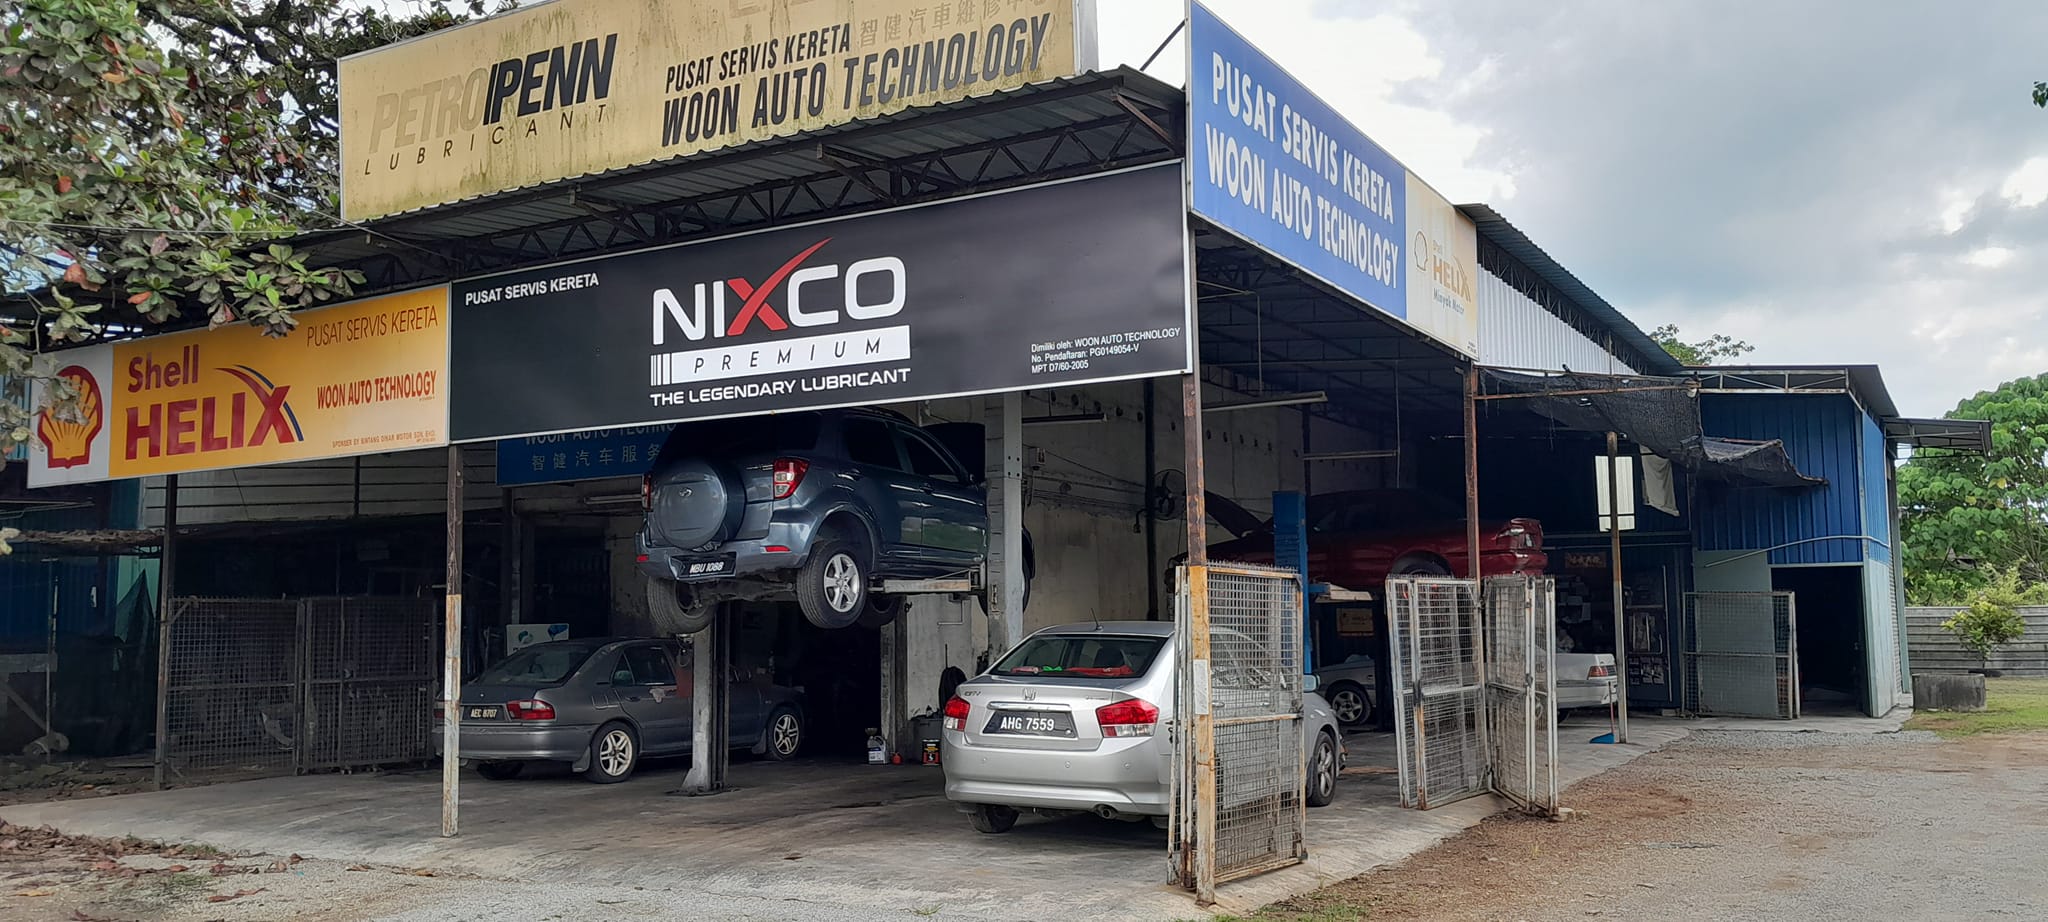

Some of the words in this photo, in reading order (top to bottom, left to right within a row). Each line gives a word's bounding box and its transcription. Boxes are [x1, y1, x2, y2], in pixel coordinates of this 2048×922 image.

[661, 83, 741, 147] WOON
[751, 62, 827, 128] AUTO
[843, 13, 1051, 110] TECHNOLOGY
[665, 55, 713, 93] PUSAT
[719, 39, 779, 81] SERVIS
[784, 23, 851, 64] KERETA
[364, 104, 607, 175] LUBRICANT
[1213, 51, 1276, 142] PUSAT
[1282, 103, 1339, 186] SERVIS
[1343, 150, 1394, 225] KERETA
[1205, 123, 1266, 214] WOON
[1271, 168, 1314, 241] AUTO
[1317, 195, 1400, 289] TECHNOLOGY
[465, 288, 503, 307] PUSAT
[504, 280, 548, 301] SERVIS
[549, 273, 599, 294] KERETA
[652, 237, 907, 345] NIXCO
[1433, 256, 1472, 304] HELIX
[307, 323, 343, 347] PUSAT
[346, 315, 387, 343] SERVIS
[391, 305, 438, 334] KERETA
[1031, 342, 1055, 353] Dimiliki
[1056, 341, 1074, 349] oleh:
[1074, 337, 1101, 348] WOON
[1101, 334, 1123, 345] AUTO
[1123, 327, 1181, 342] TECHNOLOGY
[128, 344, 199, 393] Shell
[694, 337, 882, 374] PREMIUM
[1031, 354, 1044, 363] No.
[1045, 350, 1088, 362] Pendaftaran:
[1089, 343, 1140, 357] PG0149054-V
[1031, 363, 1048, 374] MPT
[1049, 359, 1089, 373] D7/60-2005
[317, 384, 346, 410] WOON
[348, 381, 373, 406] AUTO
[374, 369, 438, 403] TECHNOLOGY
[650, 392, 684, 407] THE
[689, 379, 796, 404] LEGENDARY
[801, 368, 911, 393] LUBRICANT
[125, 366, 298, 460] HELIX
[1000, 715, 1023, 732] AHG
[1025, 716, 1055, 732] 7559
